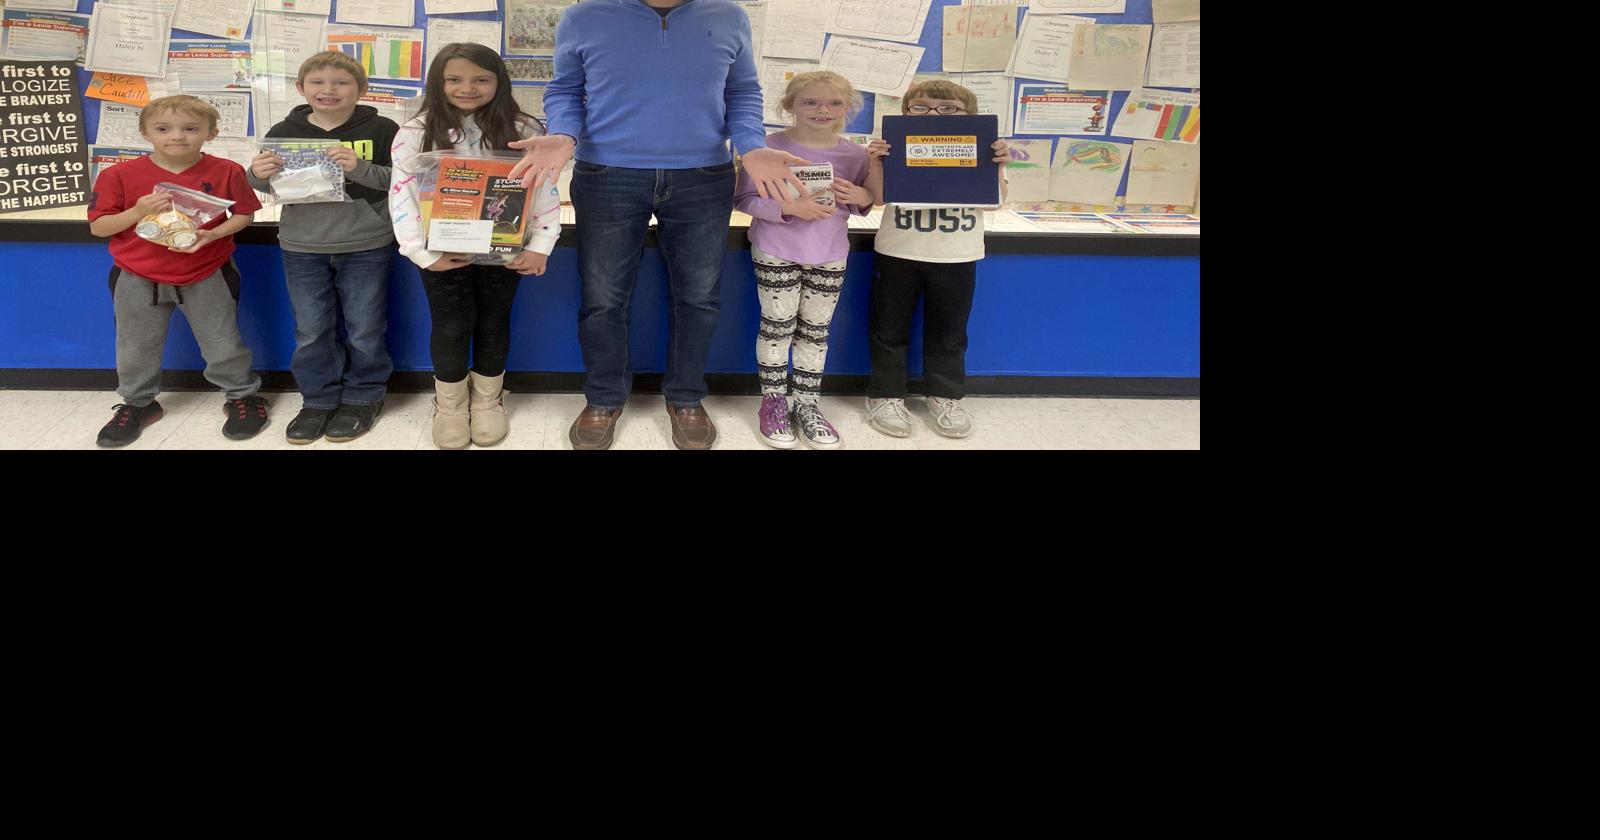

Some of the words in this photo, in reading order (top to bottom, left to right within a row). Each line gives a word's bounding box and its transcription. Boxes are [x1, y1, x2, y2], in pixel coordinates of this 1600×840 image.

[2, 65, 45, 77] first
[51, 65, 71, 77] to
[11, 95, 71, 106] BRAVEST
[9, 112, 51, 125] first
[57, 112, 77, 123] to
[0, 126, 78, 143] RGIVE
[11, 143, 78, 157] STRONGEST
[16, 162, 58, 177] first
[64, 161, 84, 172] to
[0, 200, 20, 209] HE
[23, 192, 84, 207] HAPPIEST
